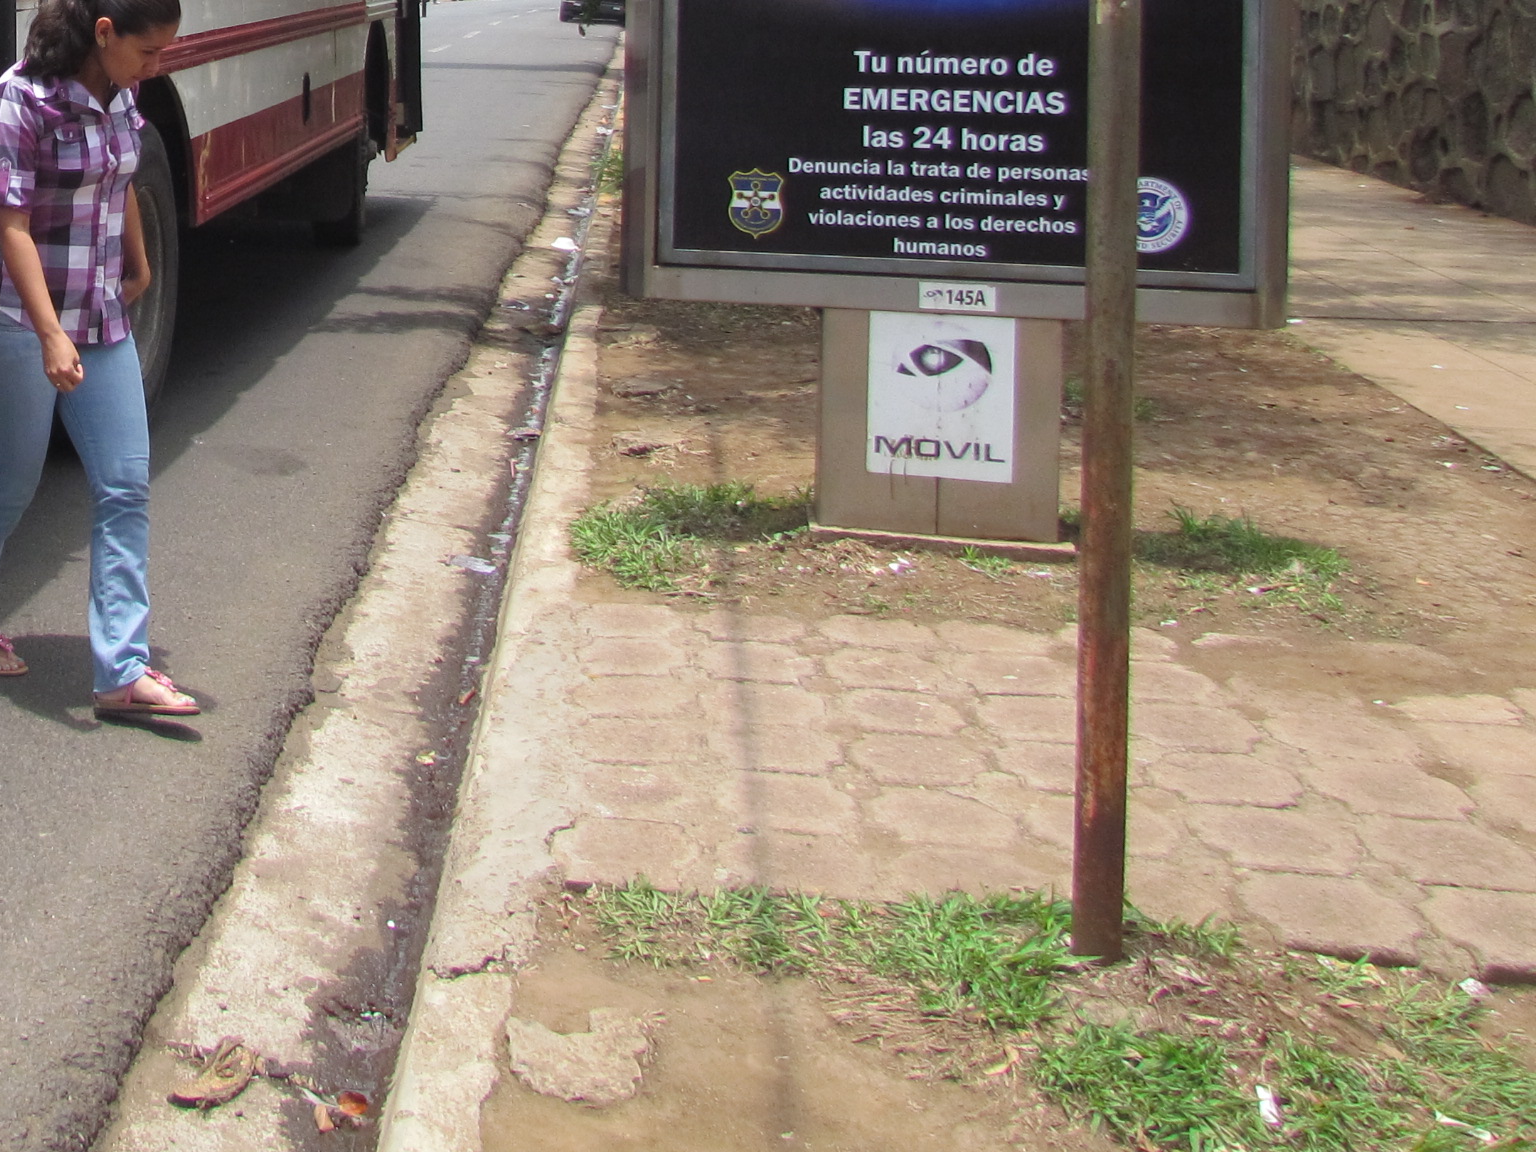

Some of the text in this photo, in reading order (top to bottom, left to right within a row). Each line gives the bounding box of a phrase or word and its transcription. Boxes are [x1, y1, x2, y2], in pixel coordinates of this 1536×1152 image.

[853, 50, 1054, 77] Tu número de
[842, 87, 1066, 115] EMERGENCIAS
[862, 125, 1044, 152] las 24 horas
[788, 157, 880, 176] Denuncia
[886, 159, 905, 176] la
[911, 160, 960, 178] trata
[966, 161, 991, 179] de
[819, 184, 1065, 209] actividades criminales y
[808, 208, 1077, 234] violaciones a los derechos
[893, 237, 987, 258] humanos
[946, 289, 987, 307] 145A
[873, 434, 1006, 464] MOVIL
